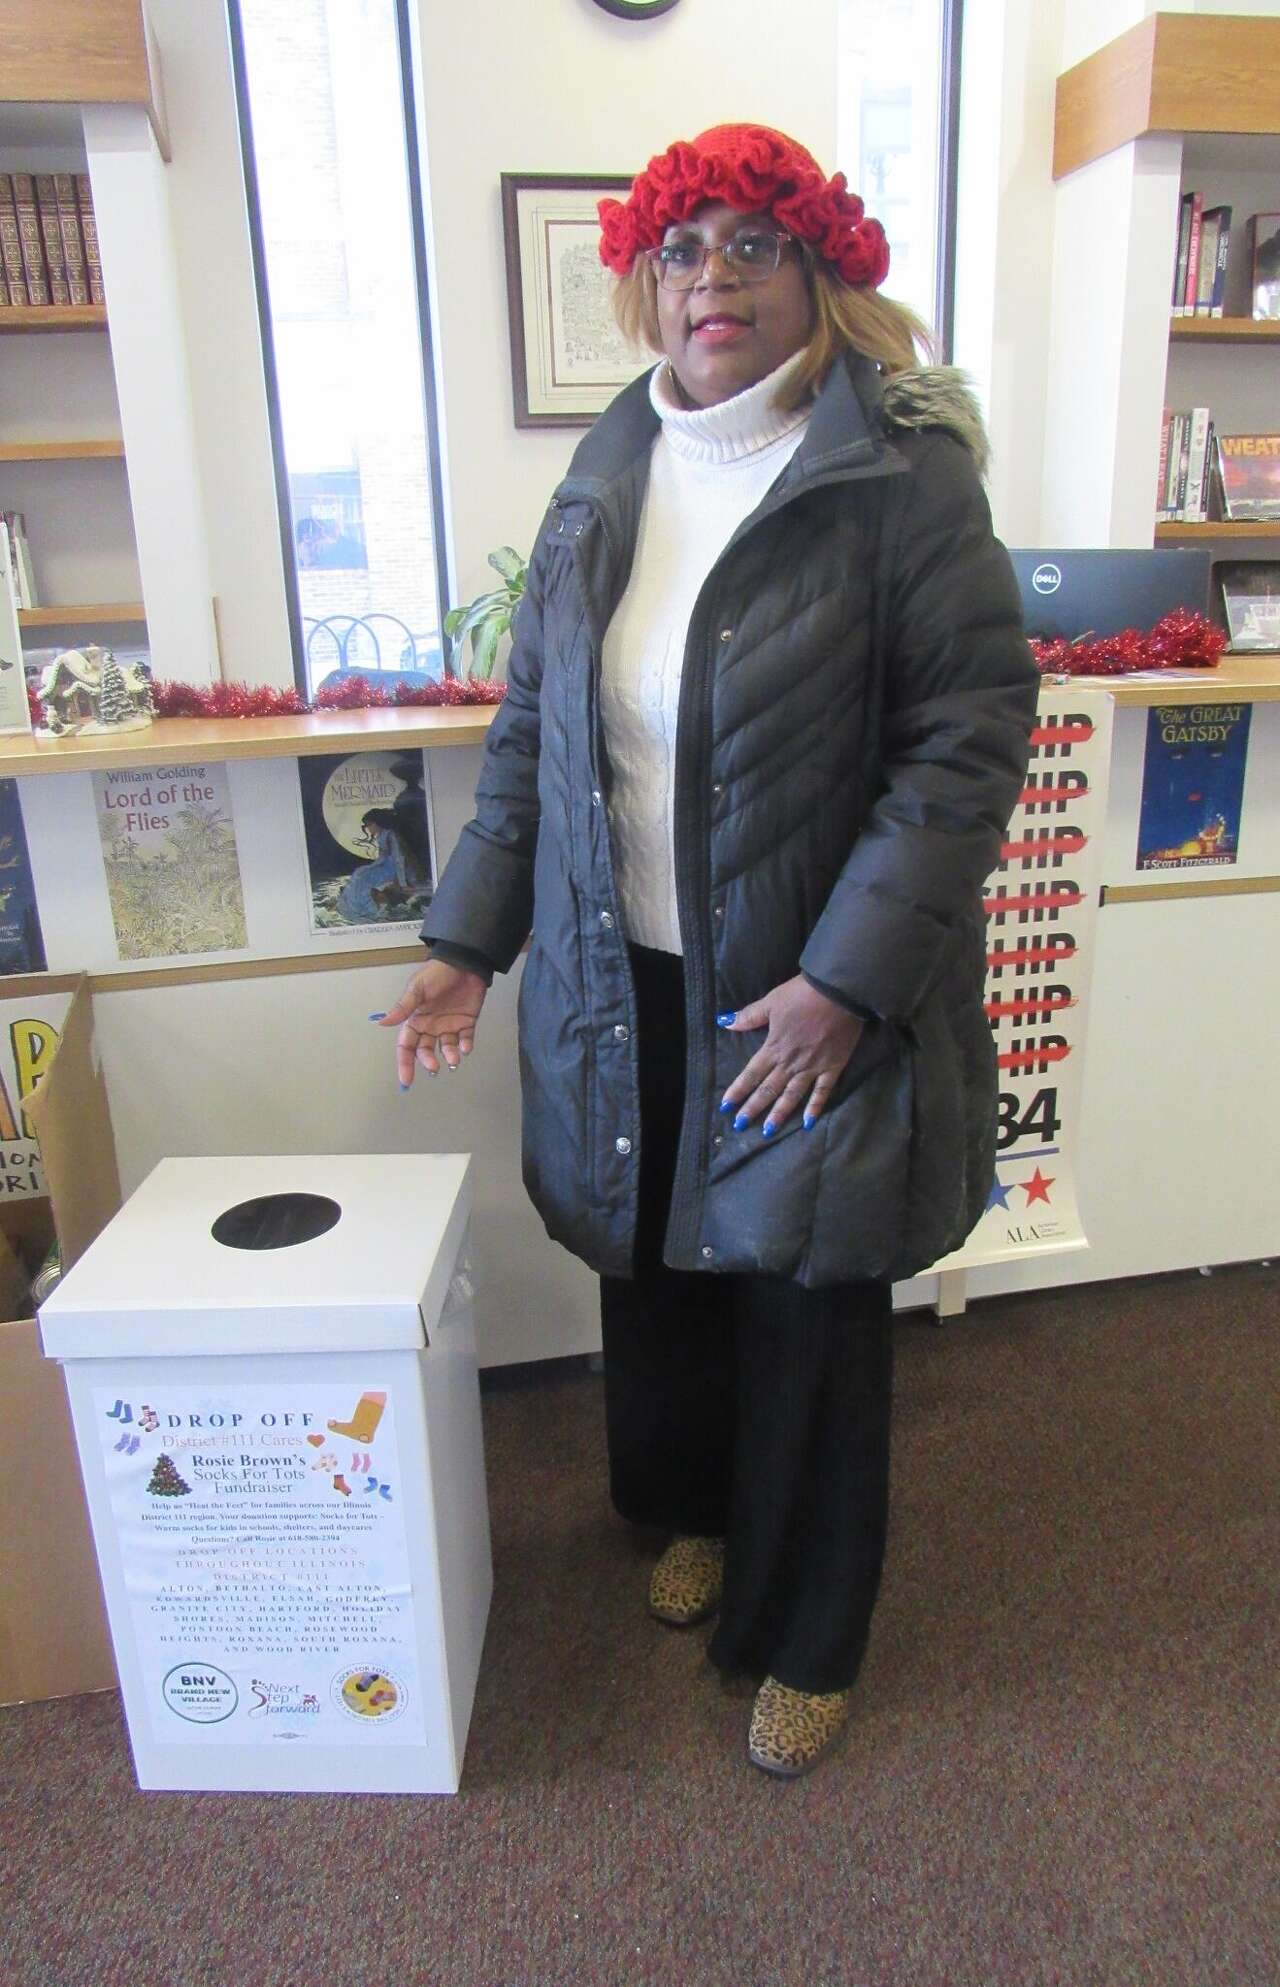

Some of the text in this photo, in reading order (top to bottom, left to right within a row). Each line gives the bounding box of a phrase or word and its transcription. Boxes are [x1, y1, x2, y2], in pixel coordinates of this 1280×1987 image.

[1036, 575, 1058, 584] DELL
[1157, 705, 1242, 724] The GREAT
[1162, 725, 1233, 743] GATSBY
[106, 766, 206, 783] William Golding
[104, 783, 214, 809] Lord of the
[331, 784, 396, 801] MERMAID
[126, 812, 170, 832] Flies
[1007, 1226, 1040, 1245] ALA
[168, 1413, 314, 1428] DROP OFF
[162, 1433, 303, 1448] District #111 Cares
[192, 1453, 306, 1467] Rosie Brown's
[194, 1467, 306, 1481] Socks For Tots
[215, 1480, 293, 1494] Fundraiser
[152, 1502, 171, 1511] Help
[250, 1501, 262, 1509] for
[265, 1501, 297, 1509] families
[141, 1513, 172, 1521] District
[219, 1512, 239, 1520] Your
[241, 1512, 278, 1520] donation
[320, 1511, 344, 1519] Socks
[154, 1524, 180, 1532] Warm
[182, 1524, 204, 1532] socks
[336, 1523, 372, 1532] daycares
[191, 1535, 234, 1544] Questions?
[255, 1534, 276, 1542] Rosie
[227, 1547, 256, 1555] OFF
[266, 1547, 358, 1555] LOCATIONS
[176, 1560, 366, 1568] THROUGHOUT ILLINOIS
[214, 1573, 288, 1581] DISTRICT
[298, 1584, 329, 1592] EAST
[181, 1676, 216, 1686] BNV
[268, 1682, 301, 1694] Next
